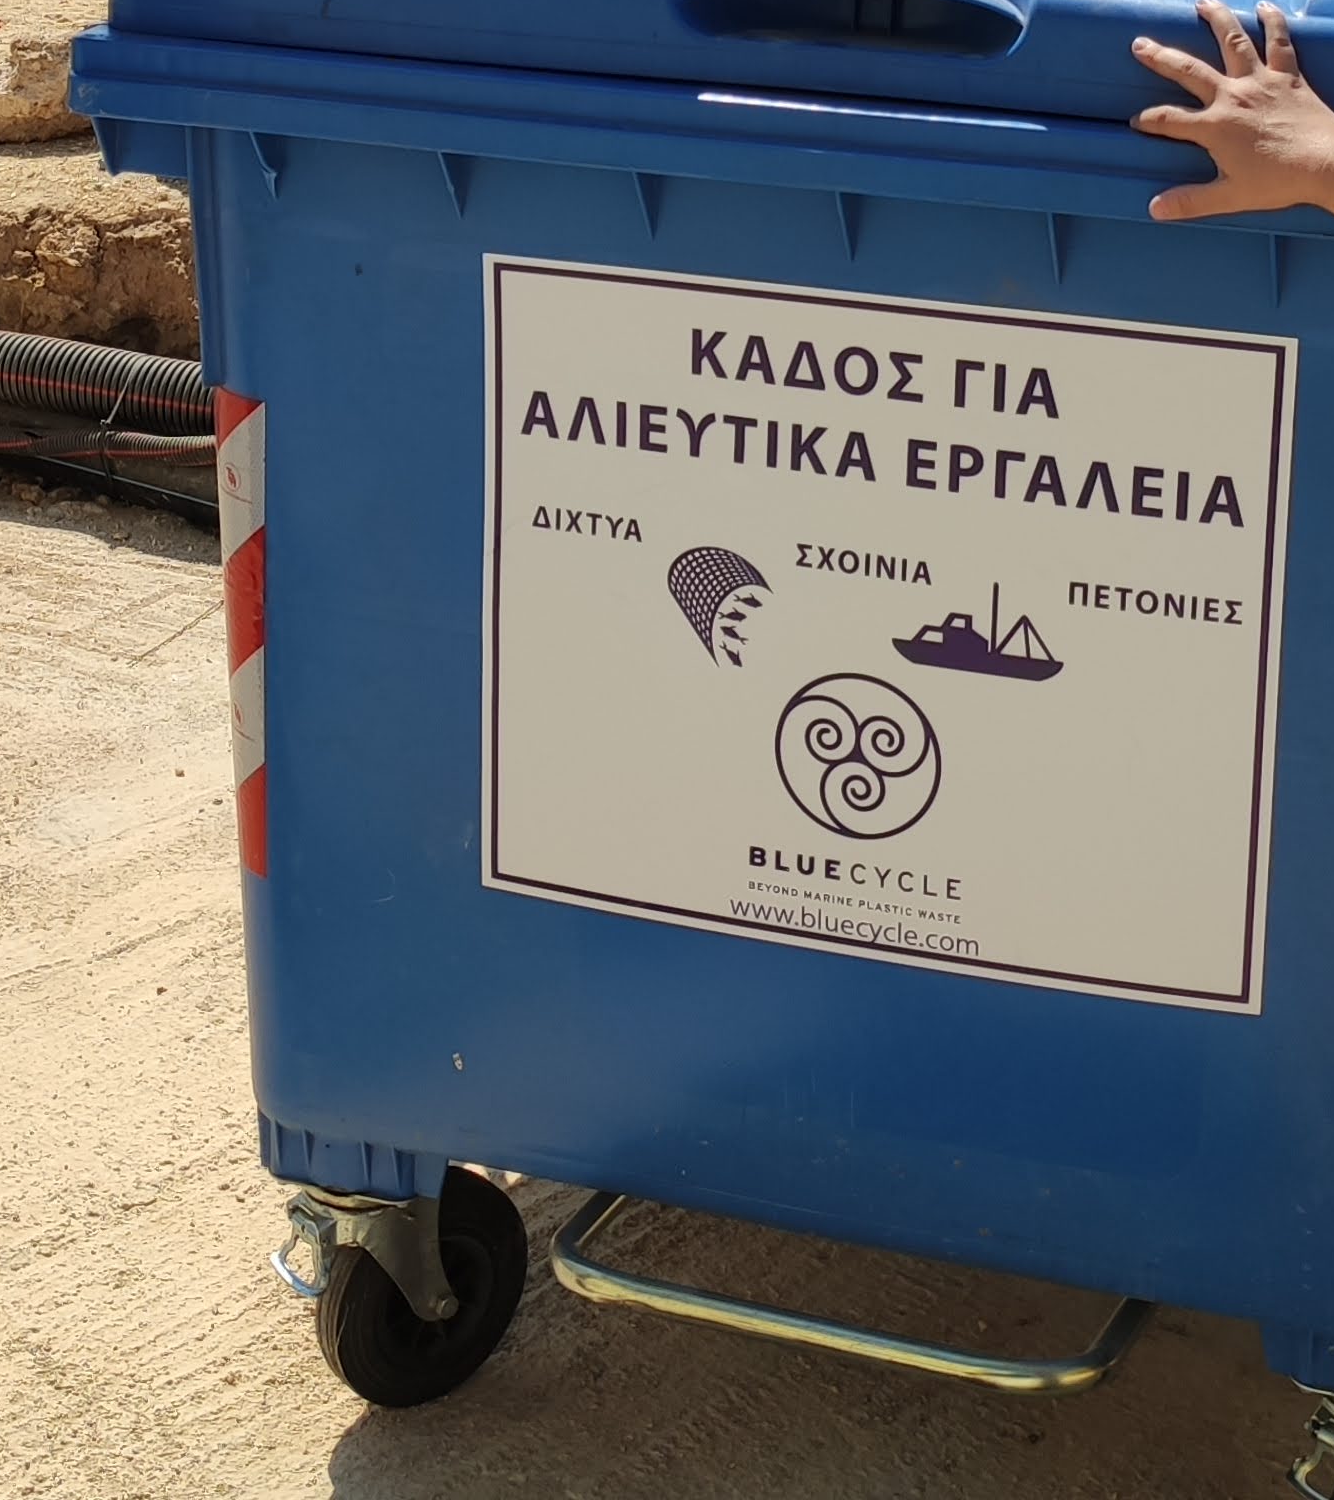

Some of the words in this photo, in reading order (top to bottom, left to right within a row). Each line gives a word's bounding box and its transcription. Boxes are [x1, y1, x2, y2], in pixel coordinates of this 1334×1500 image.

[690, 328, 924, 404] ΚΑΔΟΣ
[953, 358, 1060, 420] ΓΙΑ
[520, 390, 877, 483] ΑΛΙΕΥΤΙΚΑ
[904, 438, 1245, 528] ΕΡΓΑΛΕΙΑ
[531, 505, 643, 543] ΔΙΧΤΥΑ
[795, 542, 932, 586] ΣΧΟΙΝΙΑ
[1068, 581, 1243, 626] ΠΕΤΟΝΙΕΣ
[748, 845, 962, 901] BLUECYCLE
[748, 880, 799, 897] BEYOND
[803, 890, 853, 907] MARINE
[858, 899, 913, 917] PLASTIC
[917, 909, 961, 925] WASTE
[729, 899, 980, 957] www.bluecycle.com
